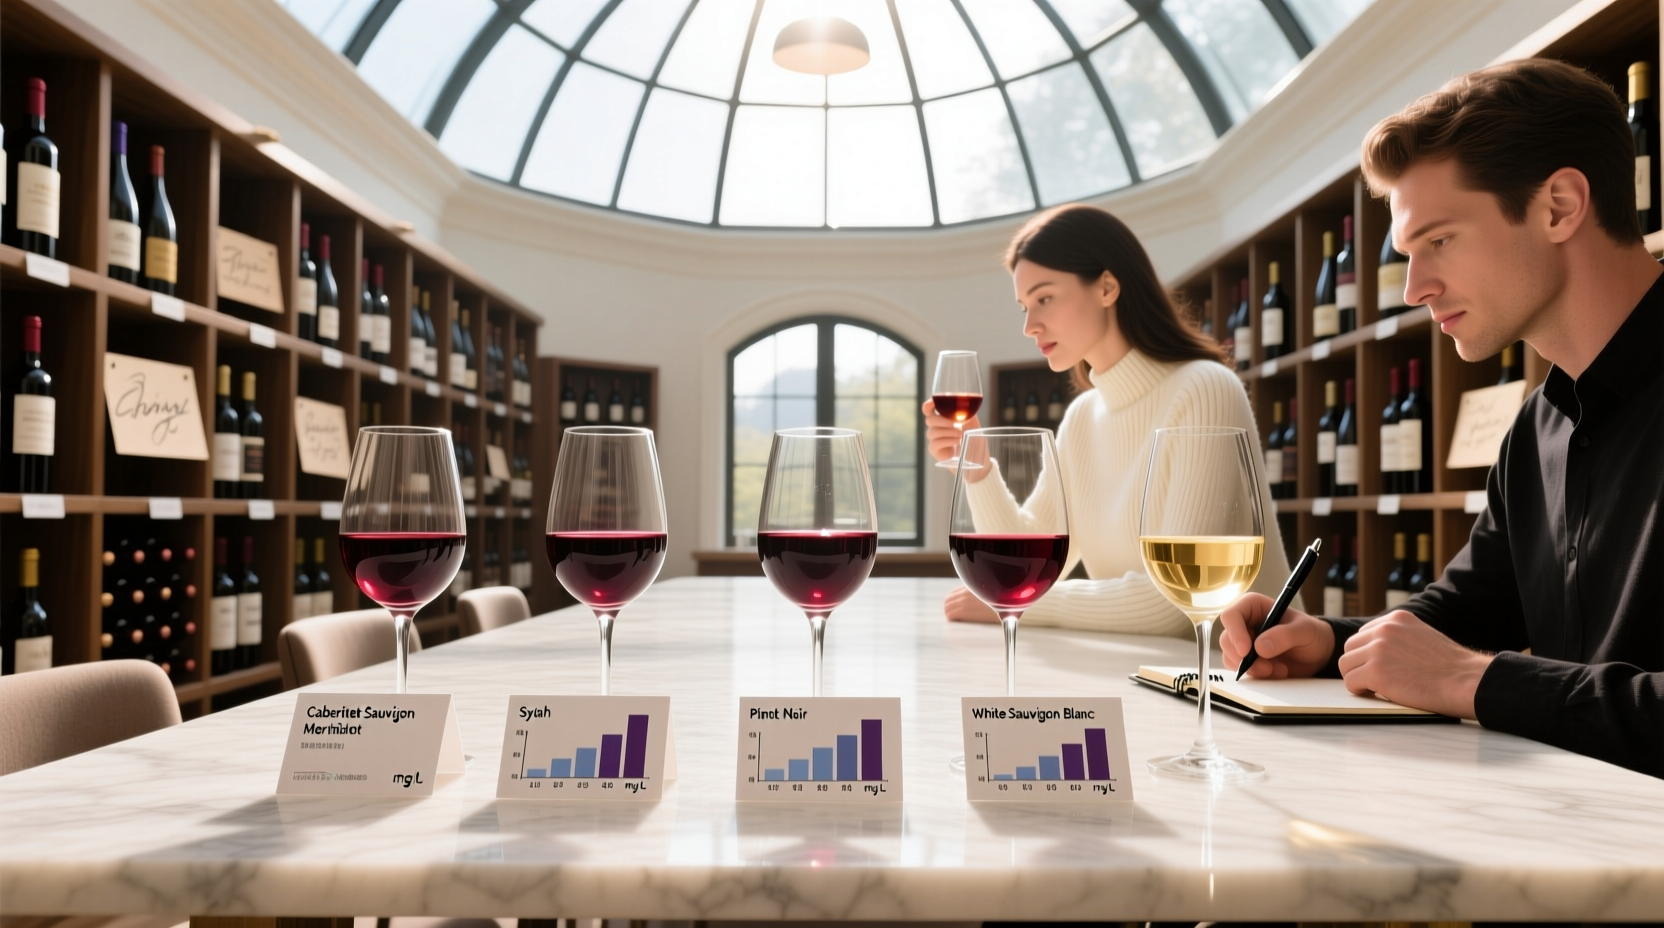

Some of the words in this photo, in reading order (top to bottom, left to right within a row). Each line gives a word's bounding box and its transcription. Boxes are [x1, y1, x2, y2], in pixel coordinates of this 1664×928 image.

[750, 708, 780, 720] Pinot
[783, 707, 808, 720] Noir
[972, 707, 1007, 719] White
[1008, 707, 1061, 723] Sauvigon
[1063, 707, 1095, 719] Blanc
